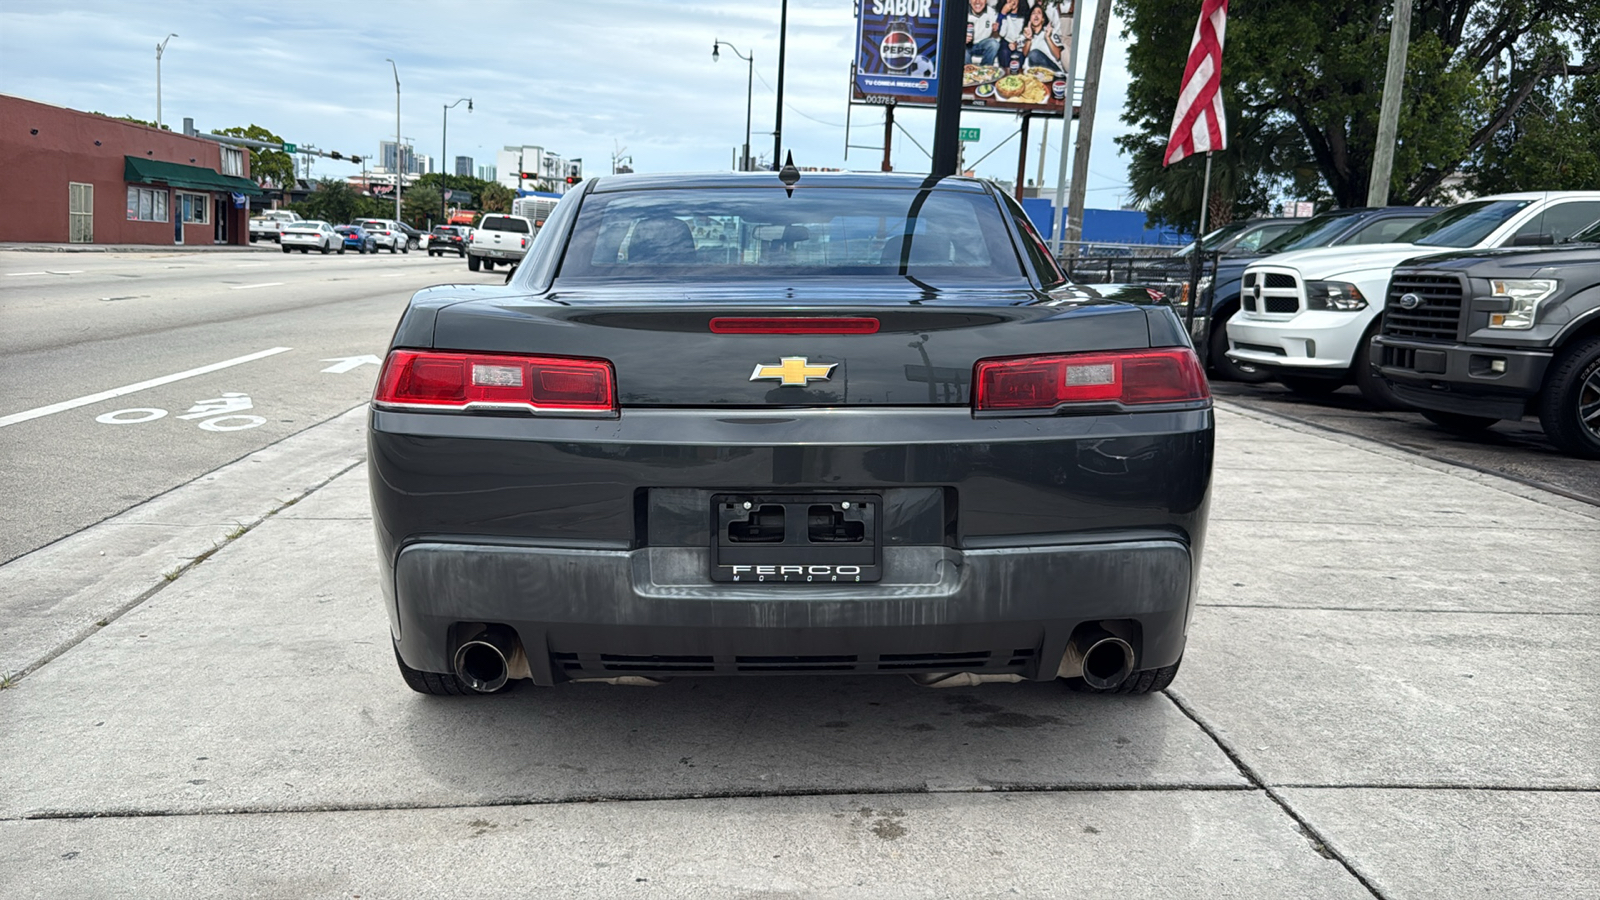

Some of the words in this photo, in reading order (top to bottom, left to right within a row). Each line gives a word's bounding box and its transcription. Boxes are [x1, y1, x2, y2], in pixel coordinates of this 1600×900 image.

[872, 0, 931, 17] SABOR
[882, 45, 915, 55] PEPSI
[732, 565, 861, 575] FERCO
